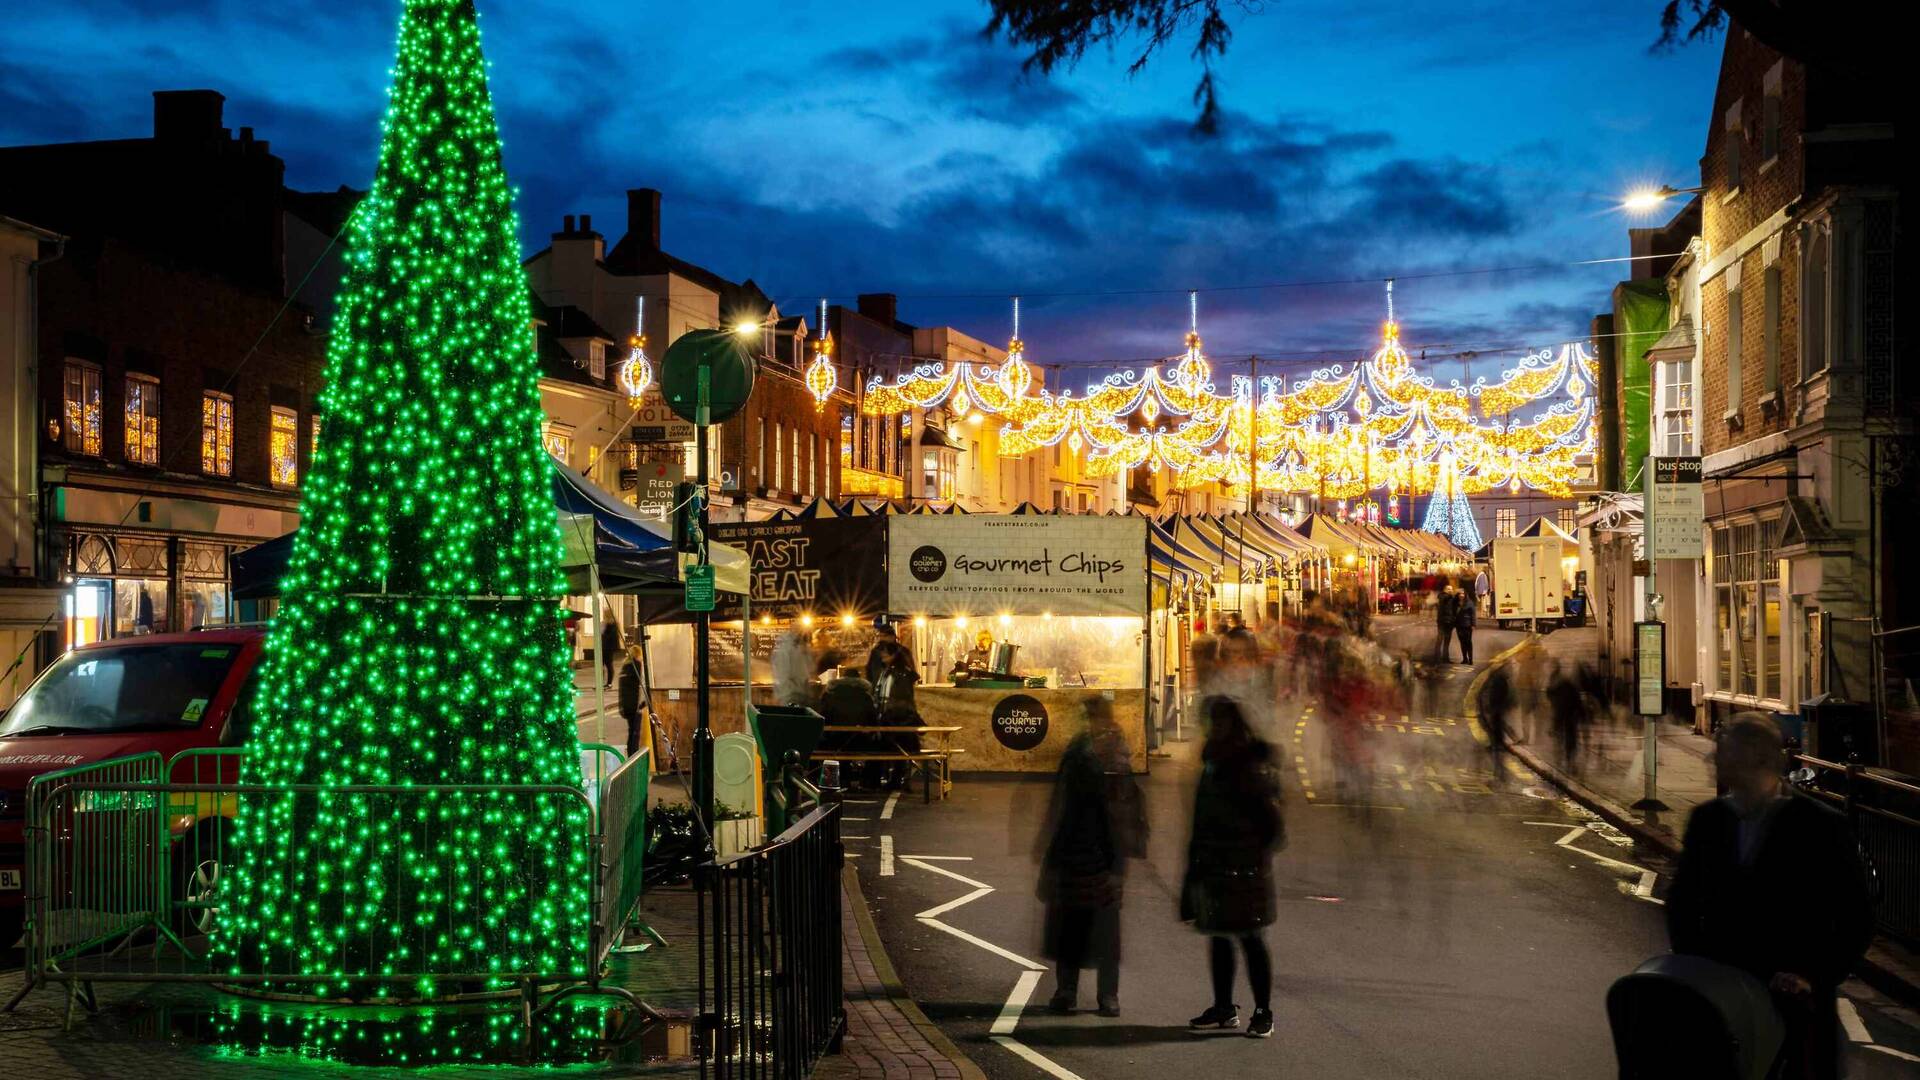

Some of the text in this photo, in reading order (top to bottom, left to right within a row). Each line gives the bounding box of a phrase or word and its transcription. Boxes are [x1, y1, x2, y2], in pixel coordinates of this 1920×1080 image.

[638, 408, 680, 421] TO LE
[1658, 460, 1702, 472] bus stop
[649, 480, 674, 488] RED
[647, 490, 675, 499] LION
[640, 500, 674, 509] COUR
[954, 548, 1125, 583] Gourmet Chips
[1011, 709, 1029, 717] the
[998, 717, 1043, 726] GOURMET
[1004, 725, 1023, 735] chip
